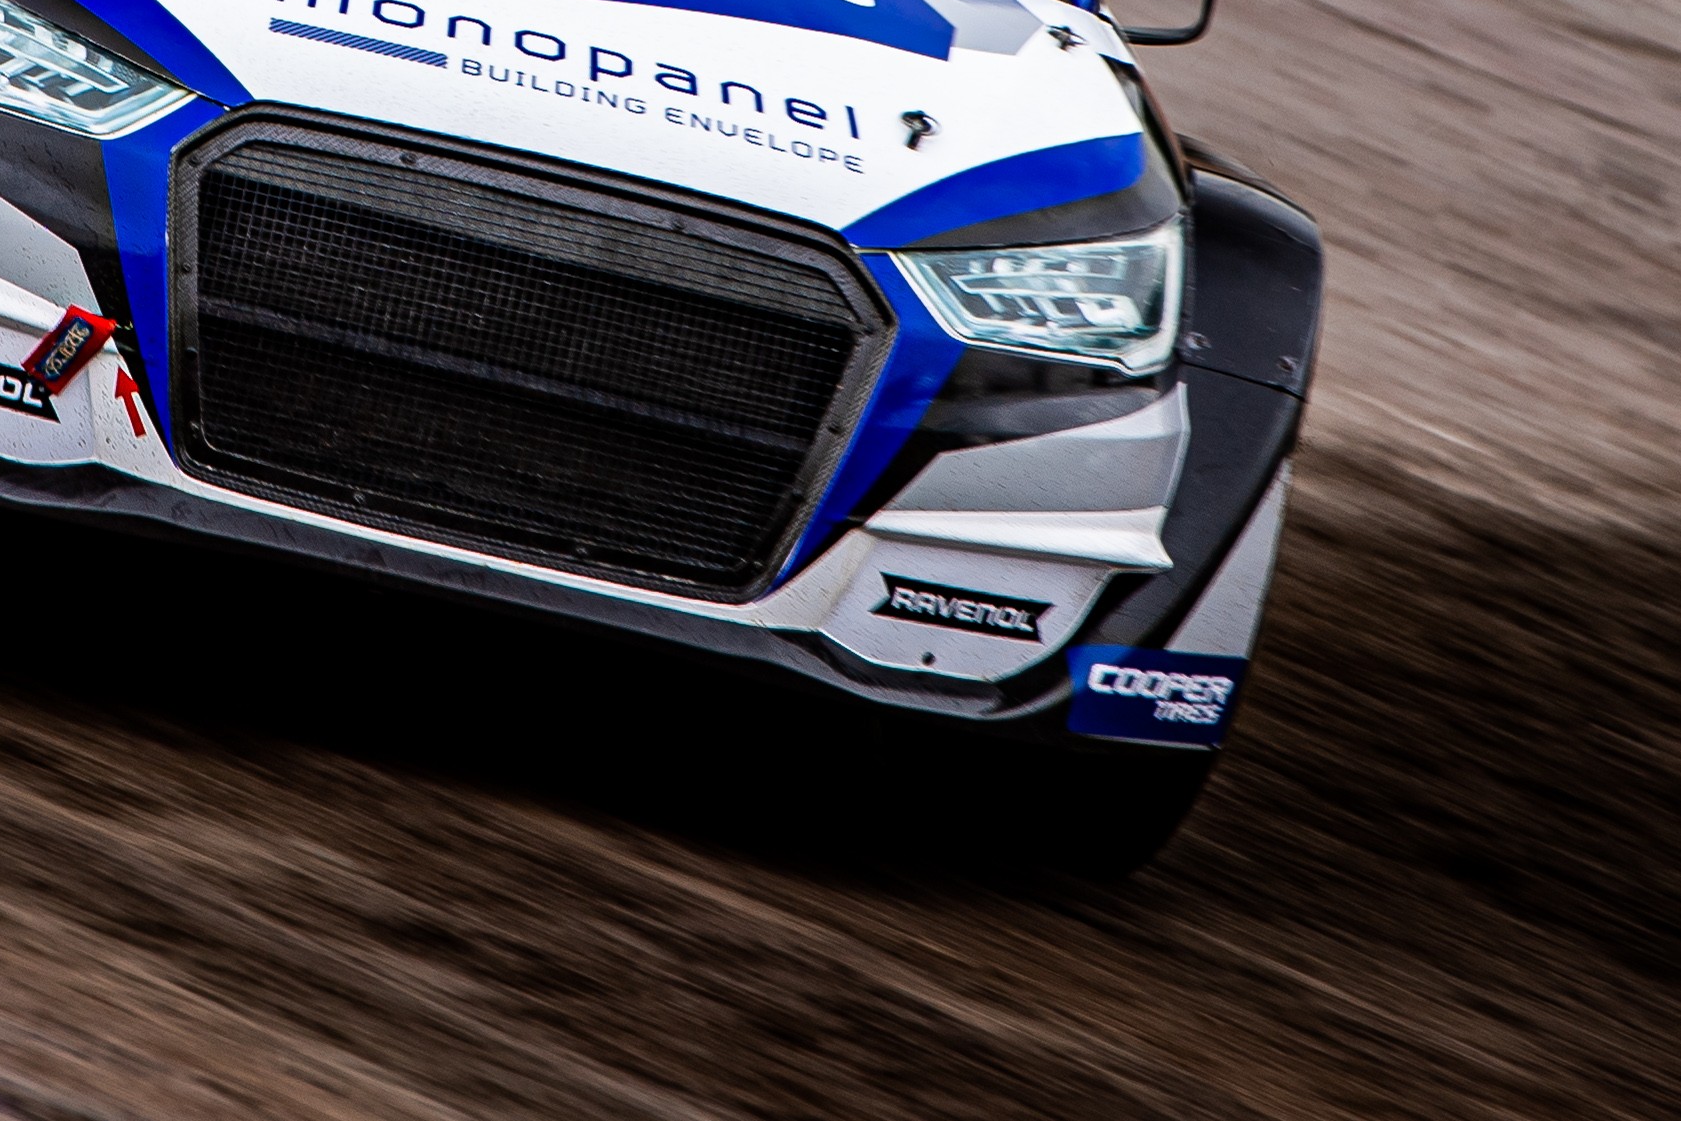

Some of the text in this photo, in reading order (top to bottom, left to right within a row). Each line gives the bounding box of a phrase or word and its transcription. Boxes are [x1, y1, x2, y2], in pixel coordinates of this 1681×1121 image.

[461, 58, 865, 175] BUILDING ENVELOPE
[890, 586, 1036, 634] RAVENOL
[1088, 663, 1234, 705] COOPER
[1153, 700, 1224, 725] TIRES
